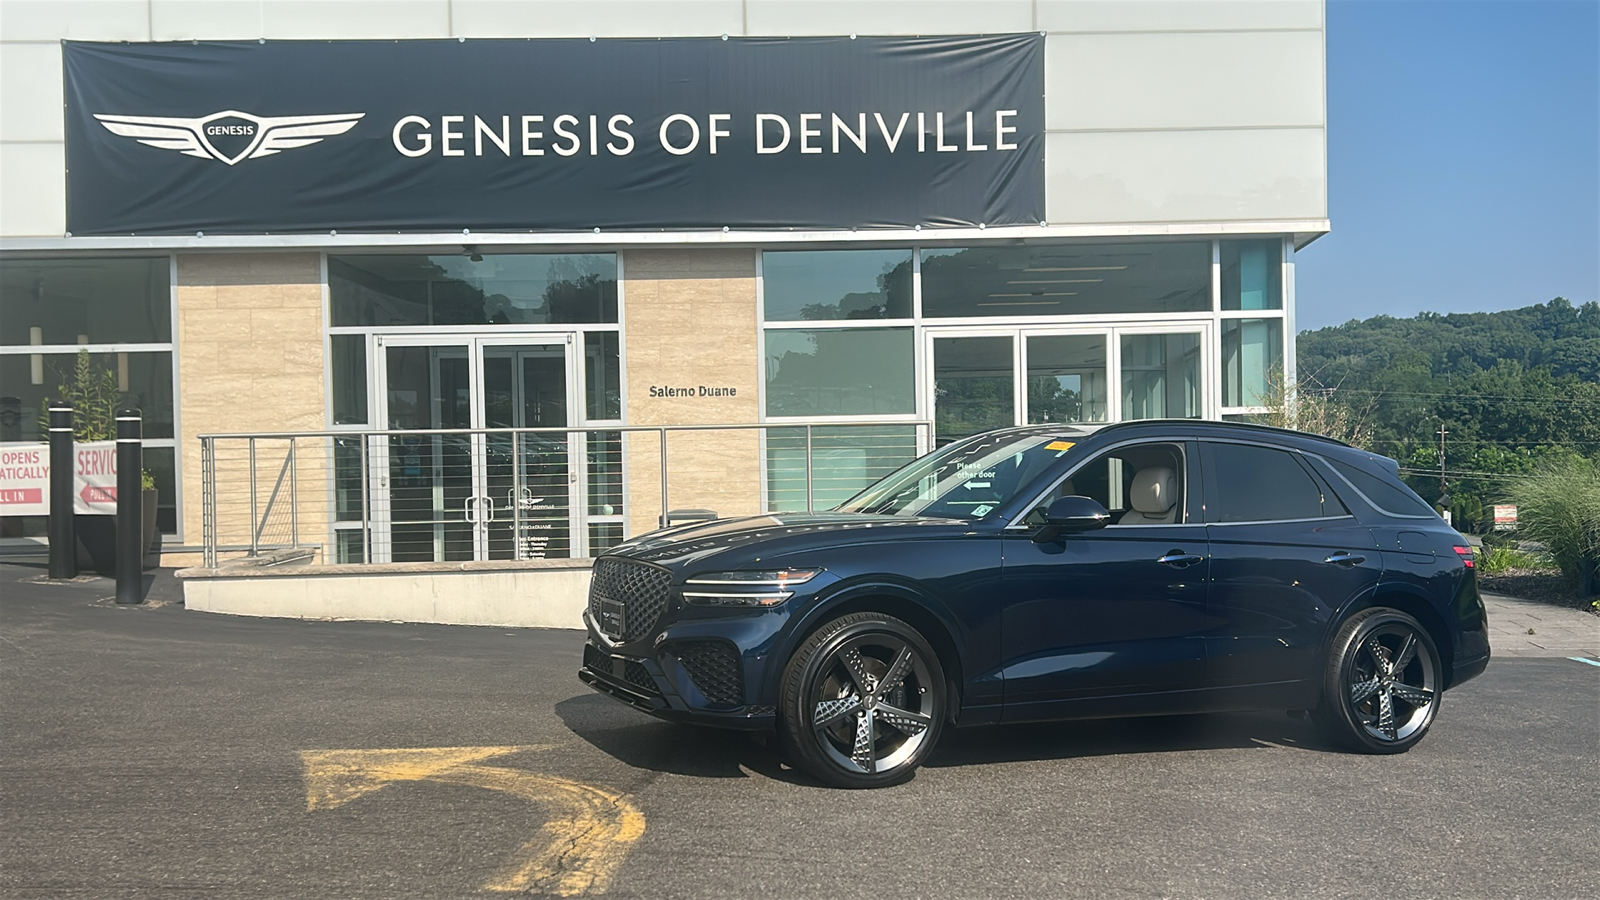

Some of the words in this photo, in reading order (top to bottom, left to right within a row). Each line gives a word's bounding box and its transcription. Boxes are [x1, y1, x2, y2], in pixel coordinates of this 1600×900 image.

[206, 125, 254, 136] GENESIS
[392, 113, 636, 158] GENESIS
[658, 113, 731, 155] OF
[755, 109, 1018, 154] DENVILLE
[649, 385, 696, 398] Salerno
[698, 385, 737, 397] Duane
[2, 451, 40, 465] OPENS
[78, 449, 117, 475] SERVIC
[956, 462, 982, 470] Please
[0, 466, 49, 480] ATICALLY
[957, 470, 977, 479] other
[978, 470, 996, 478] door
[13, 491, 24, 502] IN
[90, 488, 105, 500] PULL
